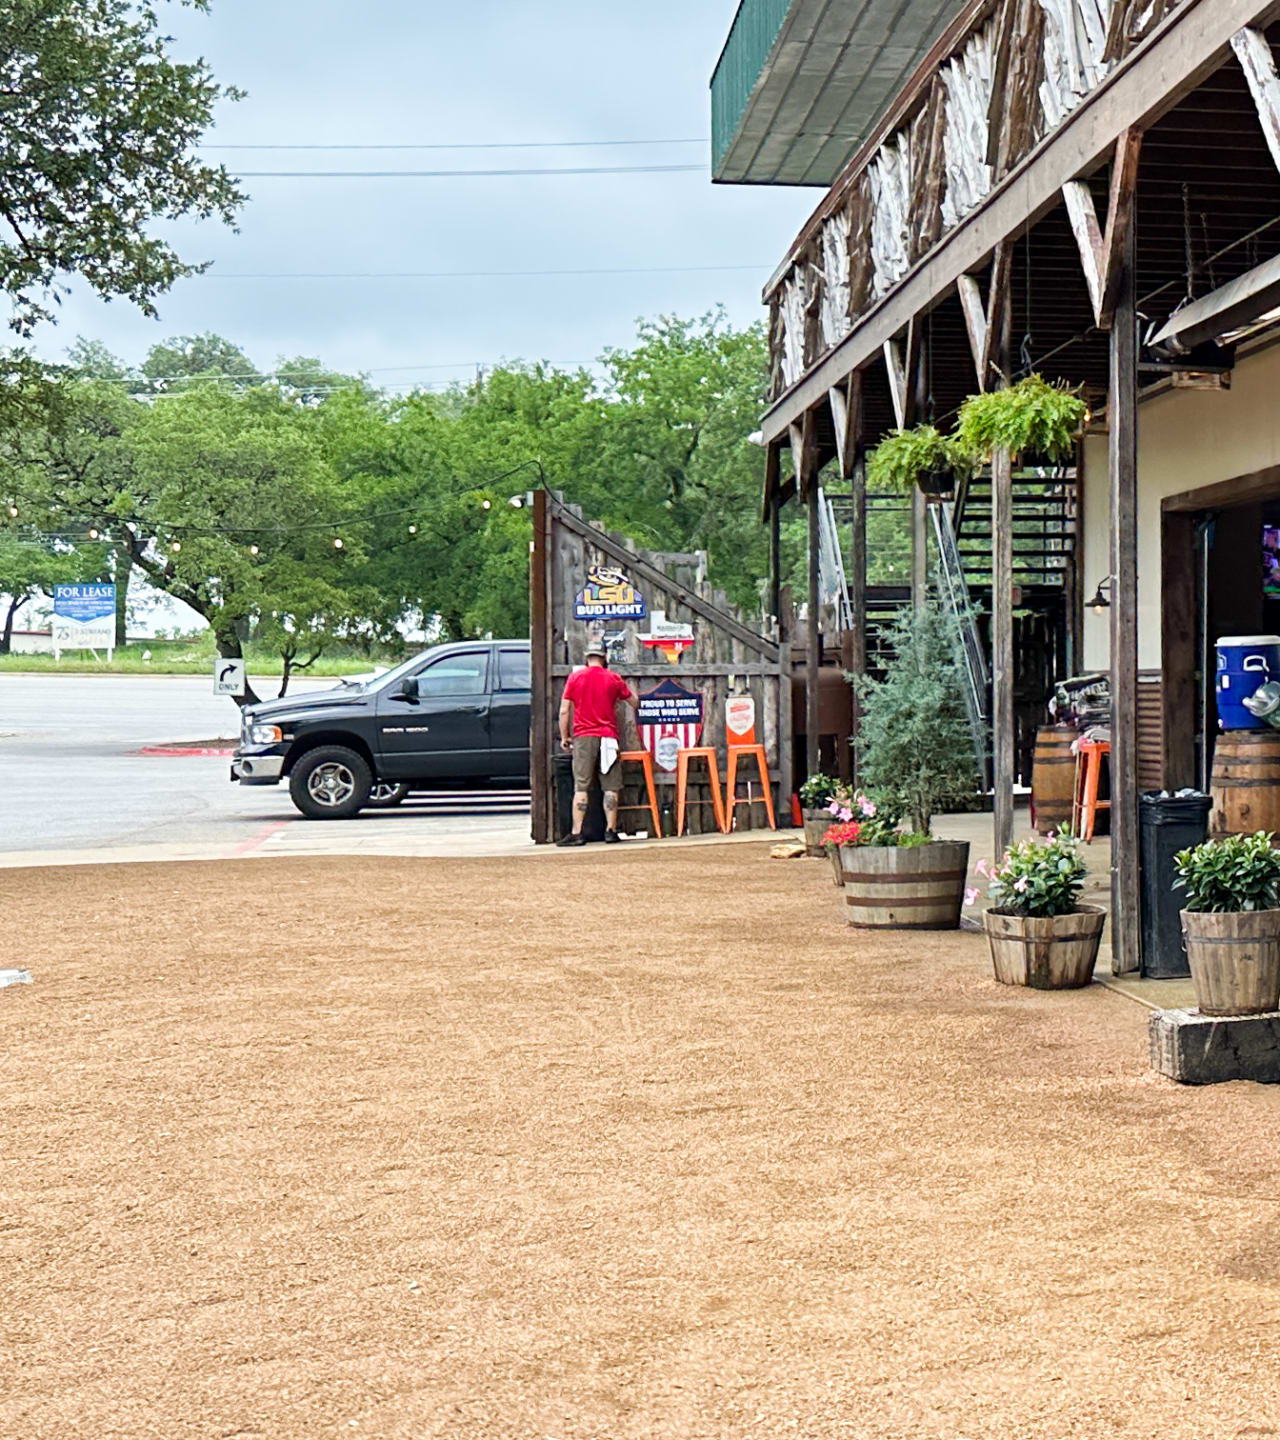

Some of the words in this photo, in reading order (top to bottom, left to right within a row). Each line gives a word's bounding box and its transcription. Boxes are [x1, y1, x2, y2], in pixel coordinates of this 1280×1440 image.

[57, 587, 80, 598] FOR
[82, 587, 113, 597] LEASE
[583, 581, 635, 605] LSU
[576, 605, 604, 615] BUD
[605, 605, 642, 615] LIGHT
[218, 683, 240, 691] ONLY
[640, 700, 665, 708] PROUD
[676, 699, 697, 707] SERVE
[638, 709, 660, 717] THOSE
[661, 708, 678, 716] WHO
[678, 707, 700, 716] SERVE
